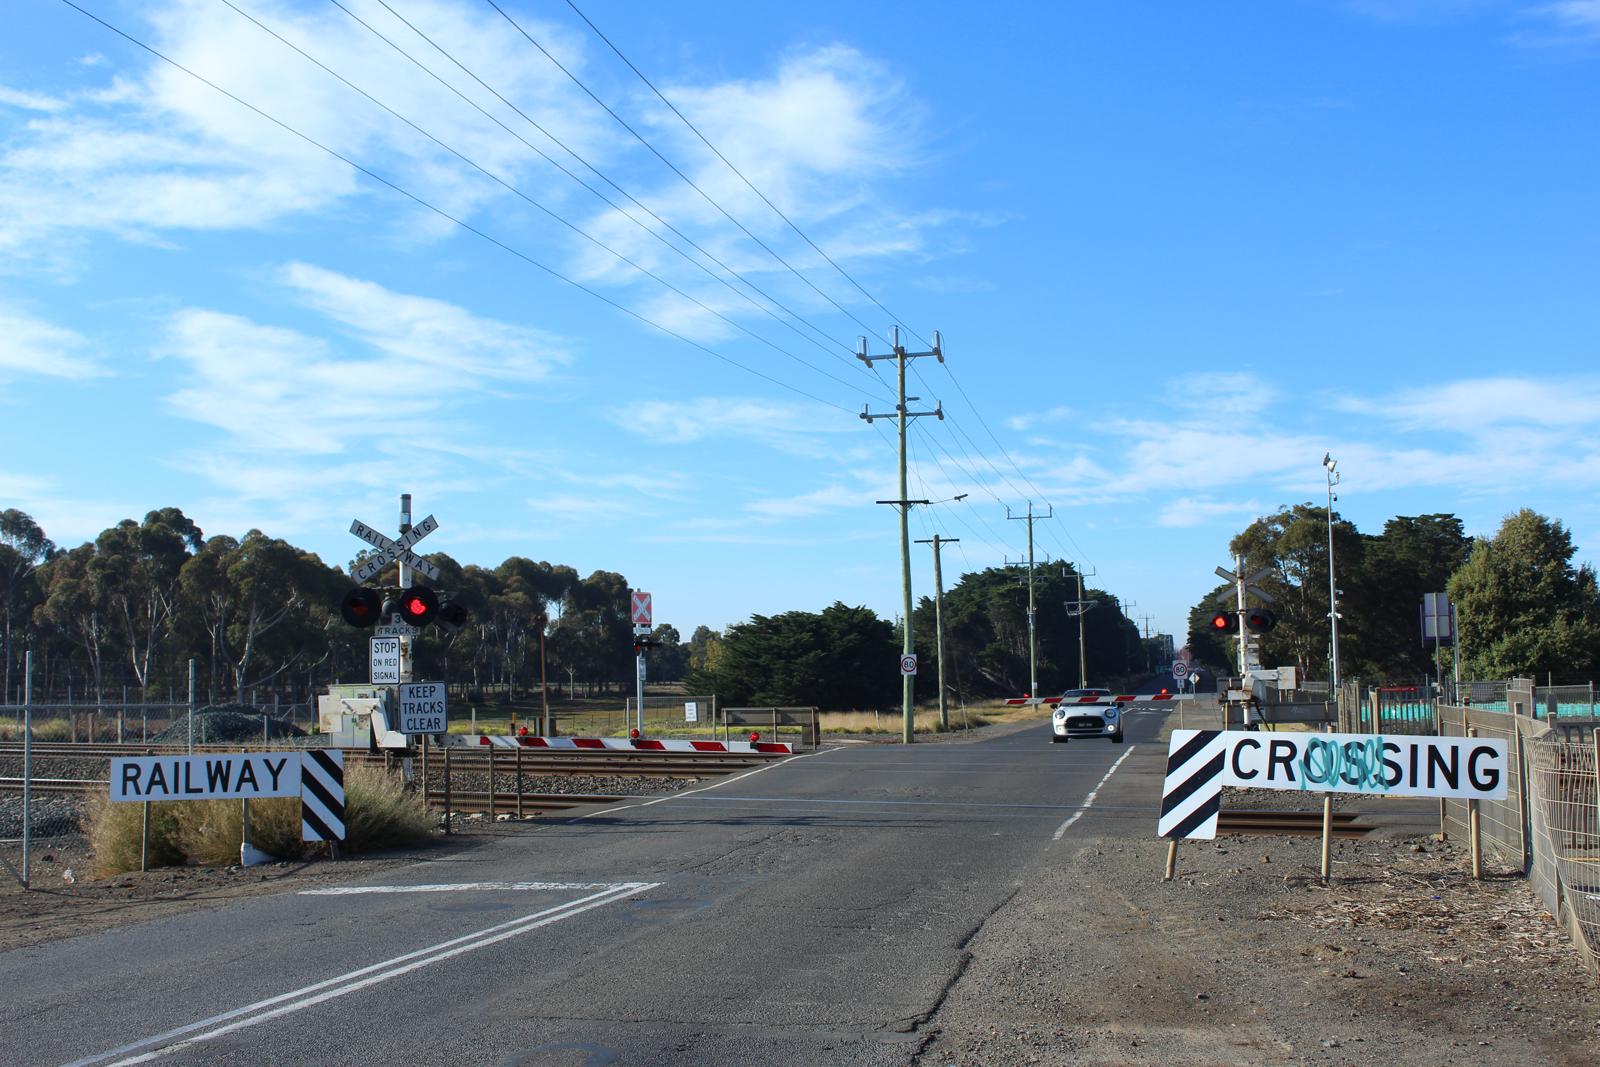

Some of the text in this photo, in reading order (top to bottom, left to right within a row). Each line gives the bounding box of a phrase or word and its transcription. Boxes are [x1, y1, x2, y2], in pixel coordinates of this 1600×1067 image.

[355, 525, 434, 575] RAIL WAY
[357, 521, 431, 579] CROSSING
[377, 626, 418, 635] TRACKS
[374, 642, 397, 653] STOP
[373, 658, 397, 666] ON RED
[373, 671, 397, 680] SIGNAL
[408, 685, 436, 698] KEEP
[402, 701, 444, 714] TRACKS
[407, 718, 441, 730] CLEAR
[1231, 738, 1500, 792] CROSSING
[121, 758, 288, 796] RAILWAY
